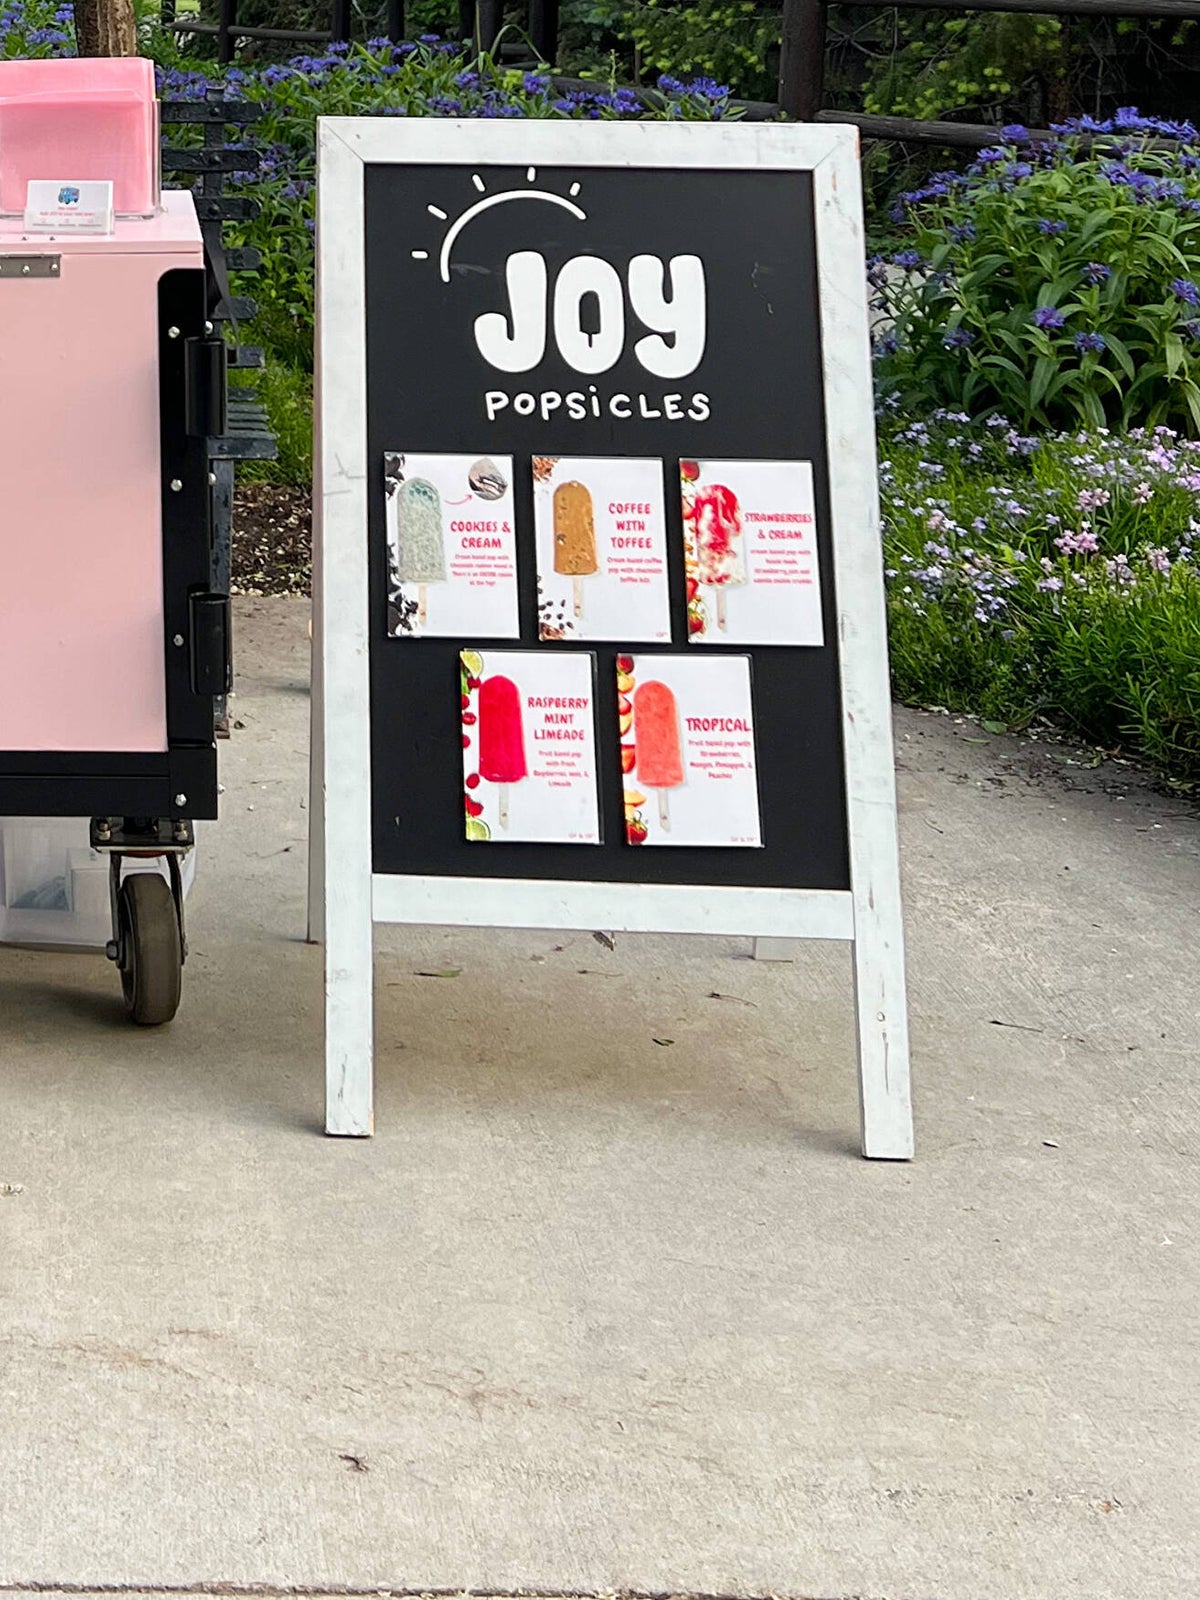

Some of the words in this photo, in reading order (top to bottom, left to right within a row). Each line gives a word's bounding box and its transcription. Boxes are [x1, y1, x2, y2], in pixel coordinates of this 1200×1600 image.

[473, 250, 707, 379] JOY
[608, 503, 651, 514] COFFEE
[745, 512, 812, 523] STRAWBERRIES
[450, 521, 497, 533] COOKIES
[502, 521, 511, 533] &
[616, 520, 645, 531] WITH
[757, 529, 766, 540] &
[769, 529, 802, 540] CREAM
[461, 537, 501, 549] CREAM
[610, 537, 652, 549] TOFFEE
[528, 697, 588, 708] RASPBERRY
[544, 713, 574, 724] MINT
[685, 718, 751, 732] TROPICAL
[534, 729, 585, 740] LIMEADE
